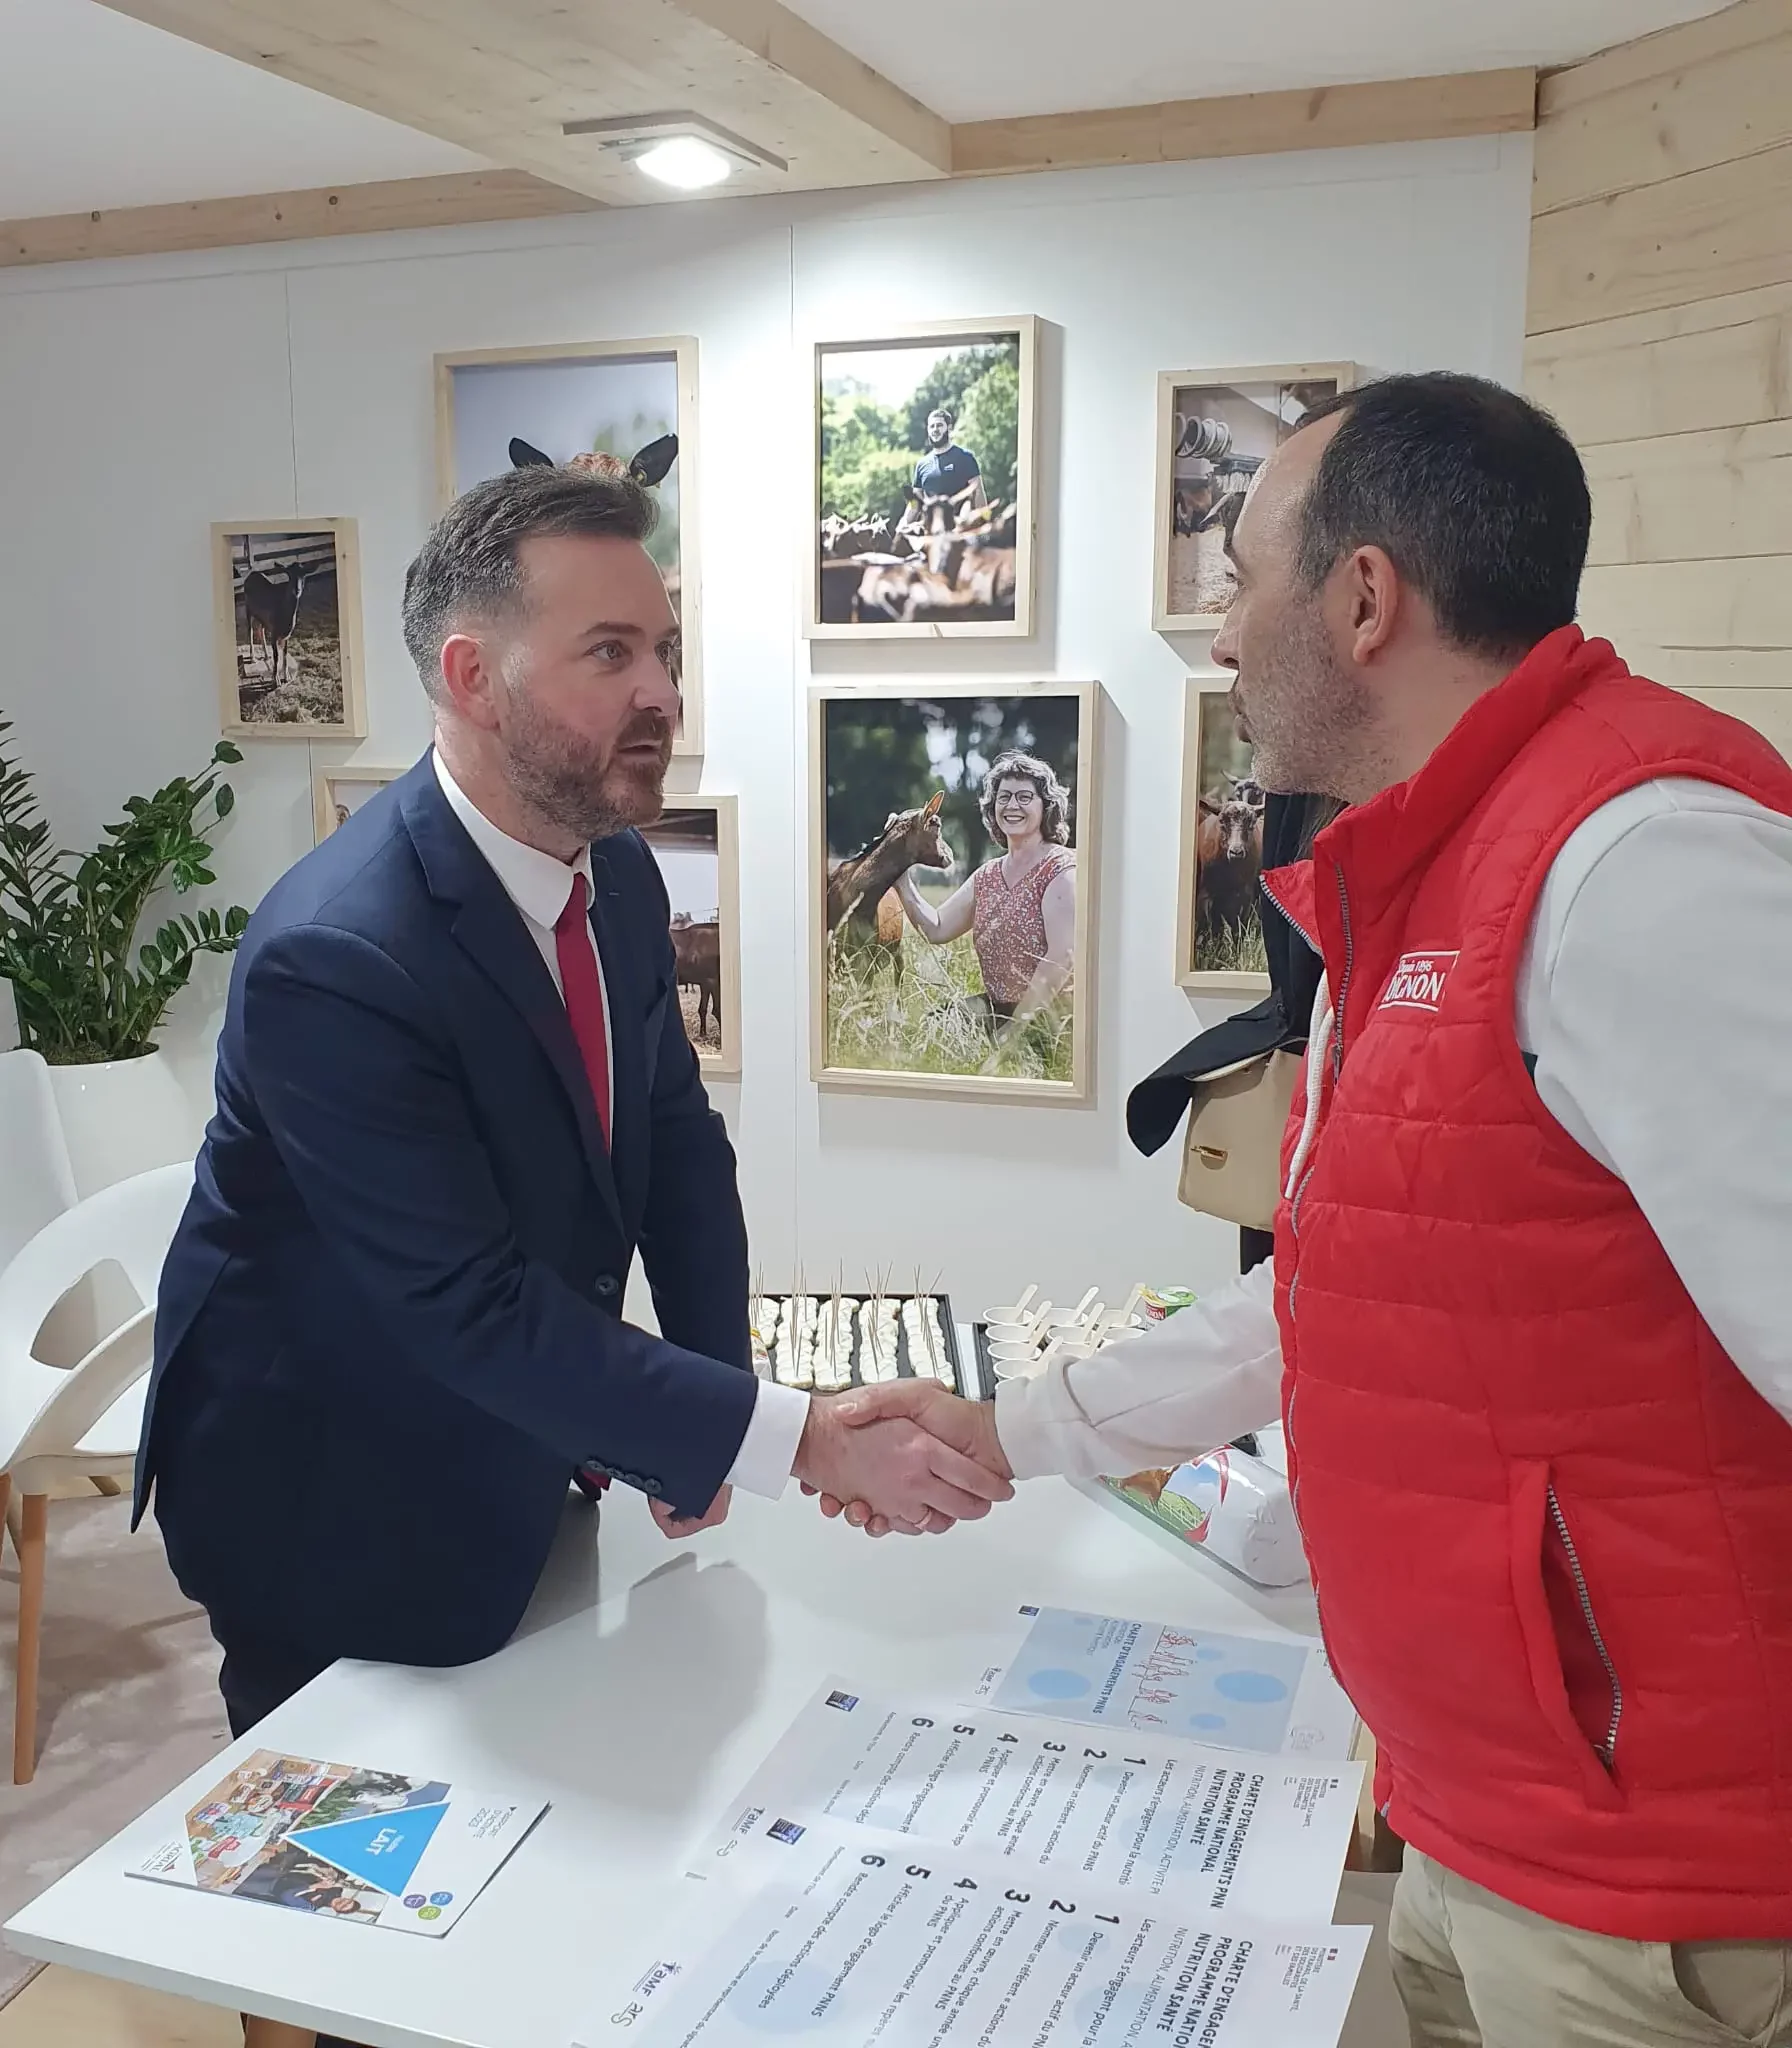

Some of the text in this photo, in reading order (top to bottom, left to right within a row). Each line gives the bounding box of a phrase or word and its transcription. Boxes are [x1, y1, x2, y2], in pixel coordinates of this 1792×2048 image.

[1124, 1623, 1142, 1646] CHARTE
[1101, 1647, 1132, 1695] D'ENGAGEMENTS
[1093, 1696, 1108, 1714] PNNS
[912, 1718, 934, 1728] 6
[953, 1725, 975, 1735] 5
[997, 1733, 1019, 1743] 4
[1043, 1741, 1066, 1752] 3
[942, 1739, 962, 1762] Afficher
[1084, 1748, 1107, 1758] 2
[928, 1769, 944, 1782] logo
[979, 1755, 995, 1774] PNNS
[991, 1749, 1013, 1778] Appliquer
[1043, 1757, 1061, 1777] Mettre
[1165, 1760, 1177, 1769] Les
[1075, 1764, 1094, 1790] Nommer
[1117, 1771, 1134, 1795] Devenir
[1154, 1771, 1170, 1795] acteurs
[1184, 1765, 1206, 1800] NUTRITION,
[997, 1755, 1044, 1837] actions conformes au PNNS
[1244, 1775, 1264, 1807] CHARTE
[903, 1783, 935, 1825] d'engagement
[966, 1787, 990, 1822] promouvoir
[1057, 1799, 1076, 1824] référent
[1104, 1804, 1118, 1824] acteur
[1140, 1797, 1162, 1832] s'engagent
[1190, 1769, 1227, 1845] NUTRITION SANTÉ
[960, 1824, 973, 1832] les
[1015, 1810, 1033, 1833] chaque
[1095, 1825, 1108, 1840] actif
[1164, 1802, 1192, 1851] ALIMENTATION,
[1201, 1772, 1245, 1872] PROGRAMME NATIONAL
[1003, 1835, 1020, 1855] année
[1043, 1830, 1060, 1854] actions
[1092, 1841, 1102, 1849] du
[1133, 1832, 1145, 1850] pour
[1218, 1809, 1253, 1885] D'ENGAGEMENTS
[860, 1854, 886, 1868] 6
[1039, 1855, 1051, 1864] du
[1083, 1850, 1099, 1871] PNNS
[843, 1872, 868, 1897] Rendre
[905, 1865, 932, 1880] 5
[953, 1878, 978, 1890] 4
[1004, 1889, 1031, 1903] 3
[1048, 1899, 1076, 1913] 2
[821, 1897, 848, 1926] compte
[926, 1895, 954, 1928] du PNNS
[939, 1898, 969, 1934] Appliquer
[1000, 1910, 1024, 1935] Mettre
[1094, 1914, 1120, 1924] 1
[811, 1926, 827, 1939] des
[932, 1935, 943, 1944] et
[992, 1937, 1004, 1946] en
[1033, 1920, 1060, 1953] Nommer
[789, 1940, 816, 1968] actions
[810, 1883, 913, 2018] Afficher le logo d'engagement PNNS
[934, 1905, 1005, 2010] actions conformes au PNNS
[1026, 1953, 1038, 1963] un
[1080, 1932, 1103, 1961] Devenir
[1156, 1927, 1188, 1972] NUTRITION,
[902, 1944, 937, 1990] promouvoir
[1074, 1962, 1085, 1972] un
[1192, 1937, 1232, 2006] PROGRAMME
[1225, 1941, 1253, 1984] CHARTE
[758, 1968, 798, 2009] déployées
[955, 1977, 979, 2006] chaque
[1006, 1964, 1032, 1996] référent
[1059, 1973, 1079, 1999] acteur
[1082, 1918, 1156, 2046] Les acteurs s'engagent pour la
[1156, 1933, 1212, 2032] NUTRITION SANTÉ
[892, 1991, 910, 2003] les
[1124, 1974, 1165, 2039] ALIMENTATION,
[938, 2008, 960, 2035] année
[984, 2004, 1008, 2034] actions
[1048, 1999, 1065, 2021] actif
[1041, 2020, 1055, 2032] du
